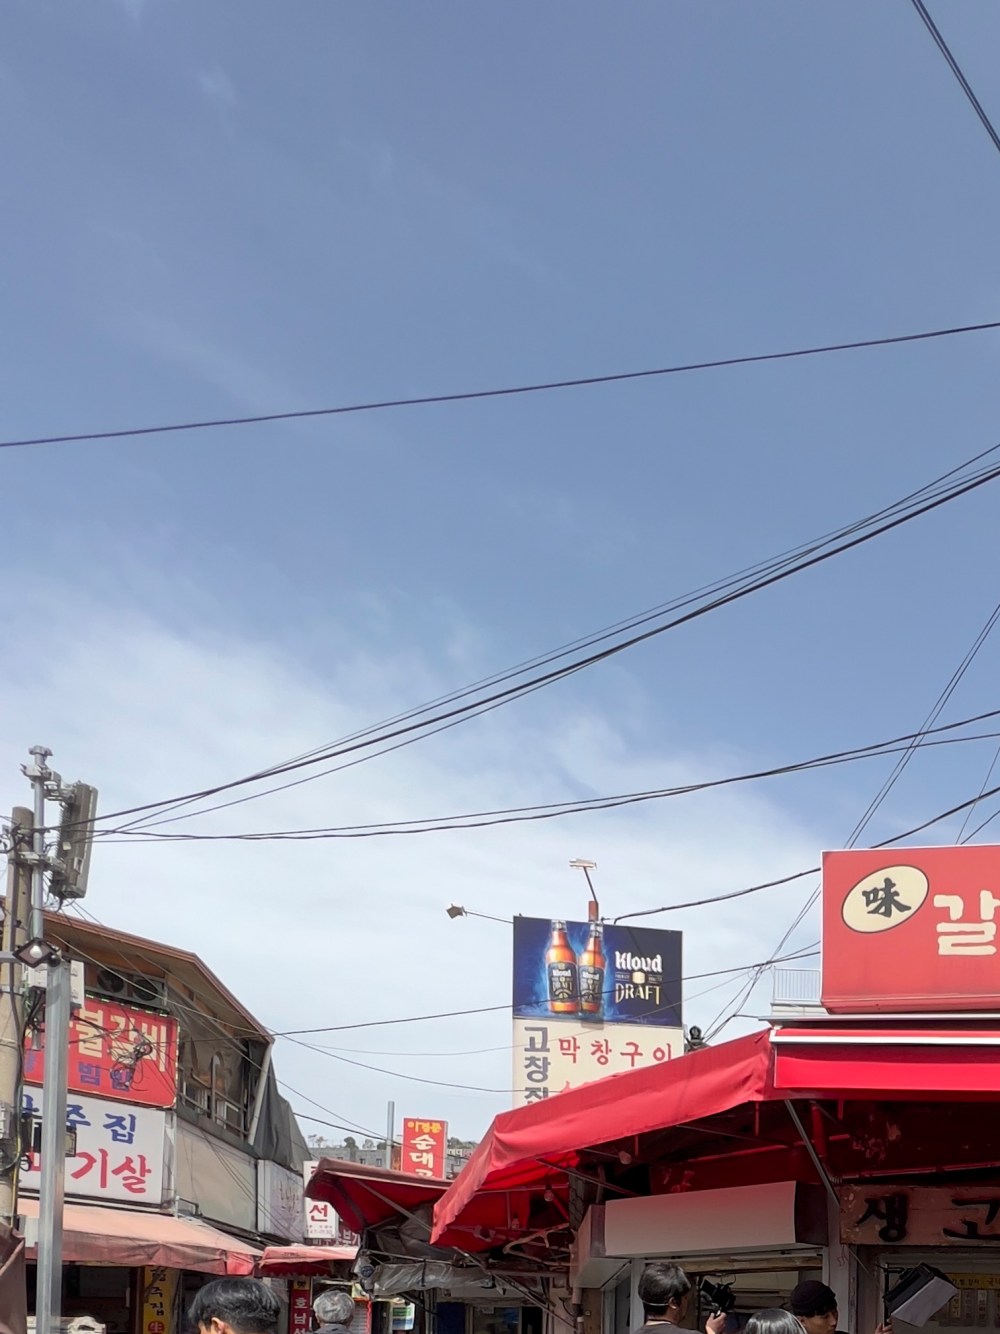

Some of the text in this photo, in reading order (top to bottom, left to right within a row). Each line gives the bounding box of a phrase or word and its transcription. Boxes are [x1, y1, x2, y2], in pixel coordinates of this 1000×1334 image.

[862, 877, 912, 920] 味
[614, 950, 662, 973] Kloud
[615, 982, 660, 1005] DRAFT
[68, 1008, 167, 1072] 불갈비
[558, 1036, 672, 1067] 막창구이
